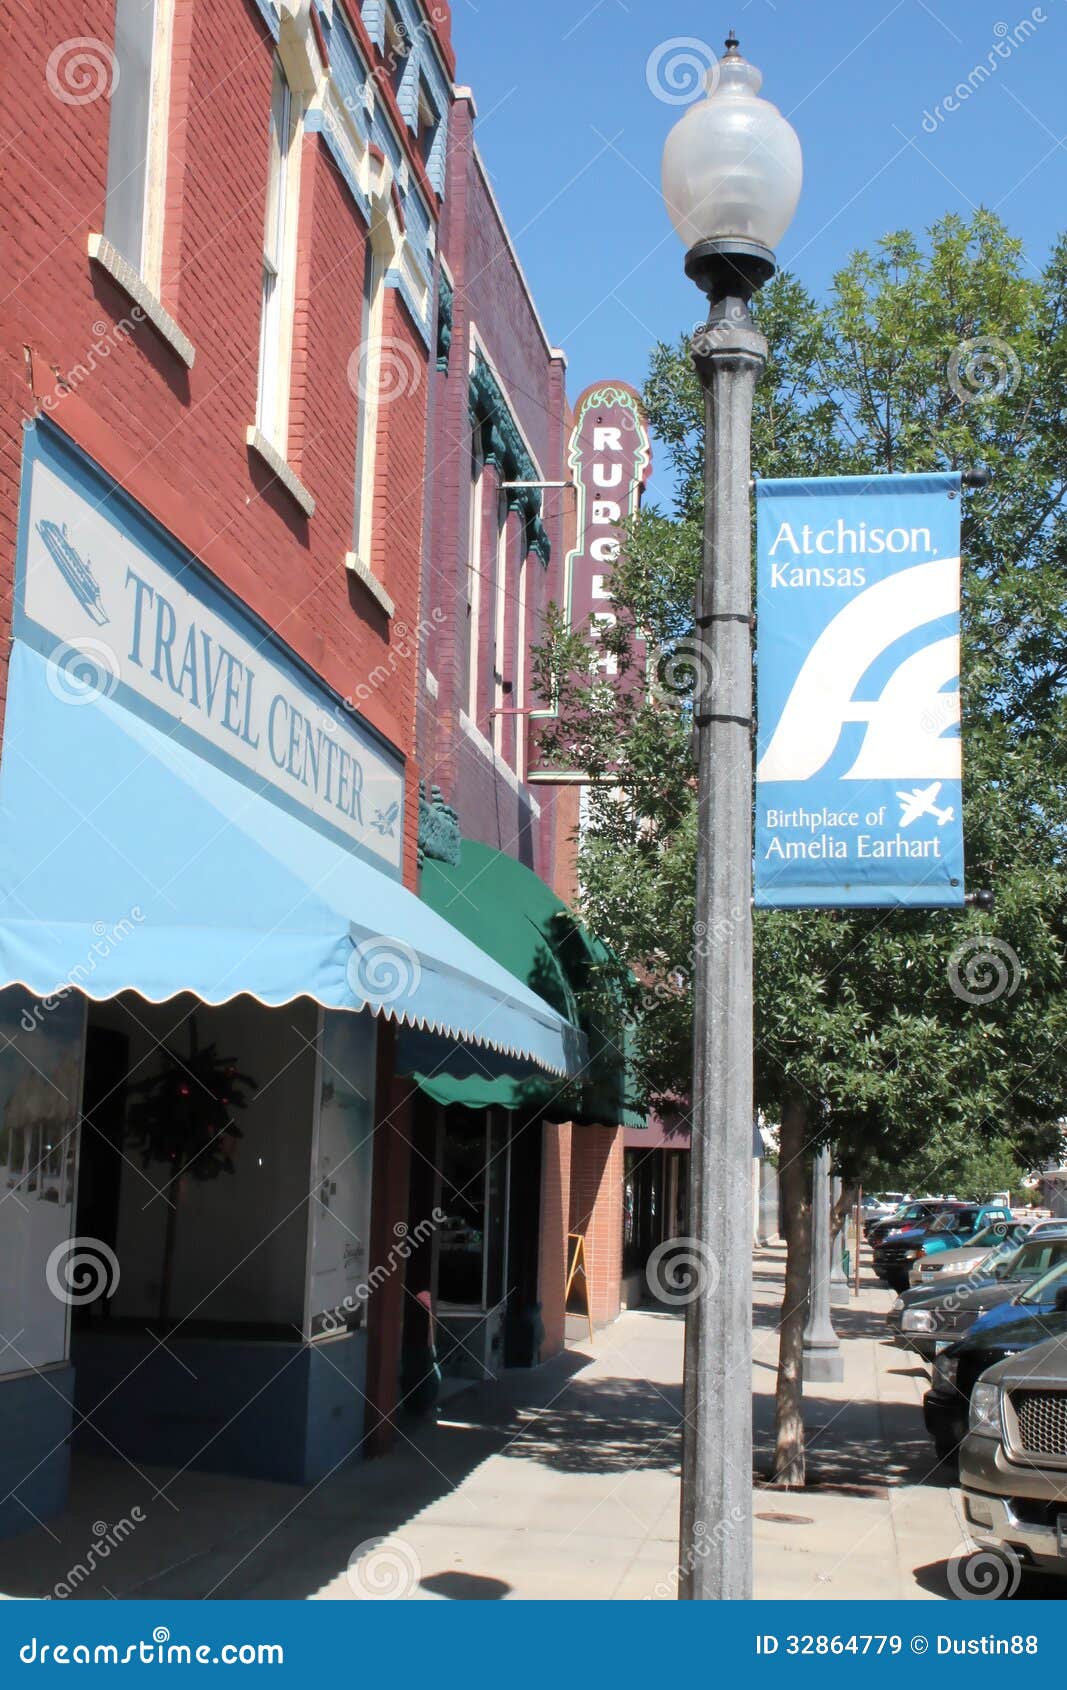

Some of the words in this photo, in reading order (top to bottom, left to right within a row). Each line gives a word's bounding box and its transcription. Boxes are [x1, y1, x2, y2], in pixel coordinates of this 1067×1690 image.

[768, 518, 938, 556] Atchison,
[770, 563, 867, 589] Kansas
[125, 565, 260, 751] TRAVEL
[267, 693, 365, 827] CENTER
[766, 808, 859, 834] Birthplace
[864, 806, 886, 827] of
[764, 833, 848, 859] Amelia
[858, 833, 941, 858] Earhart
